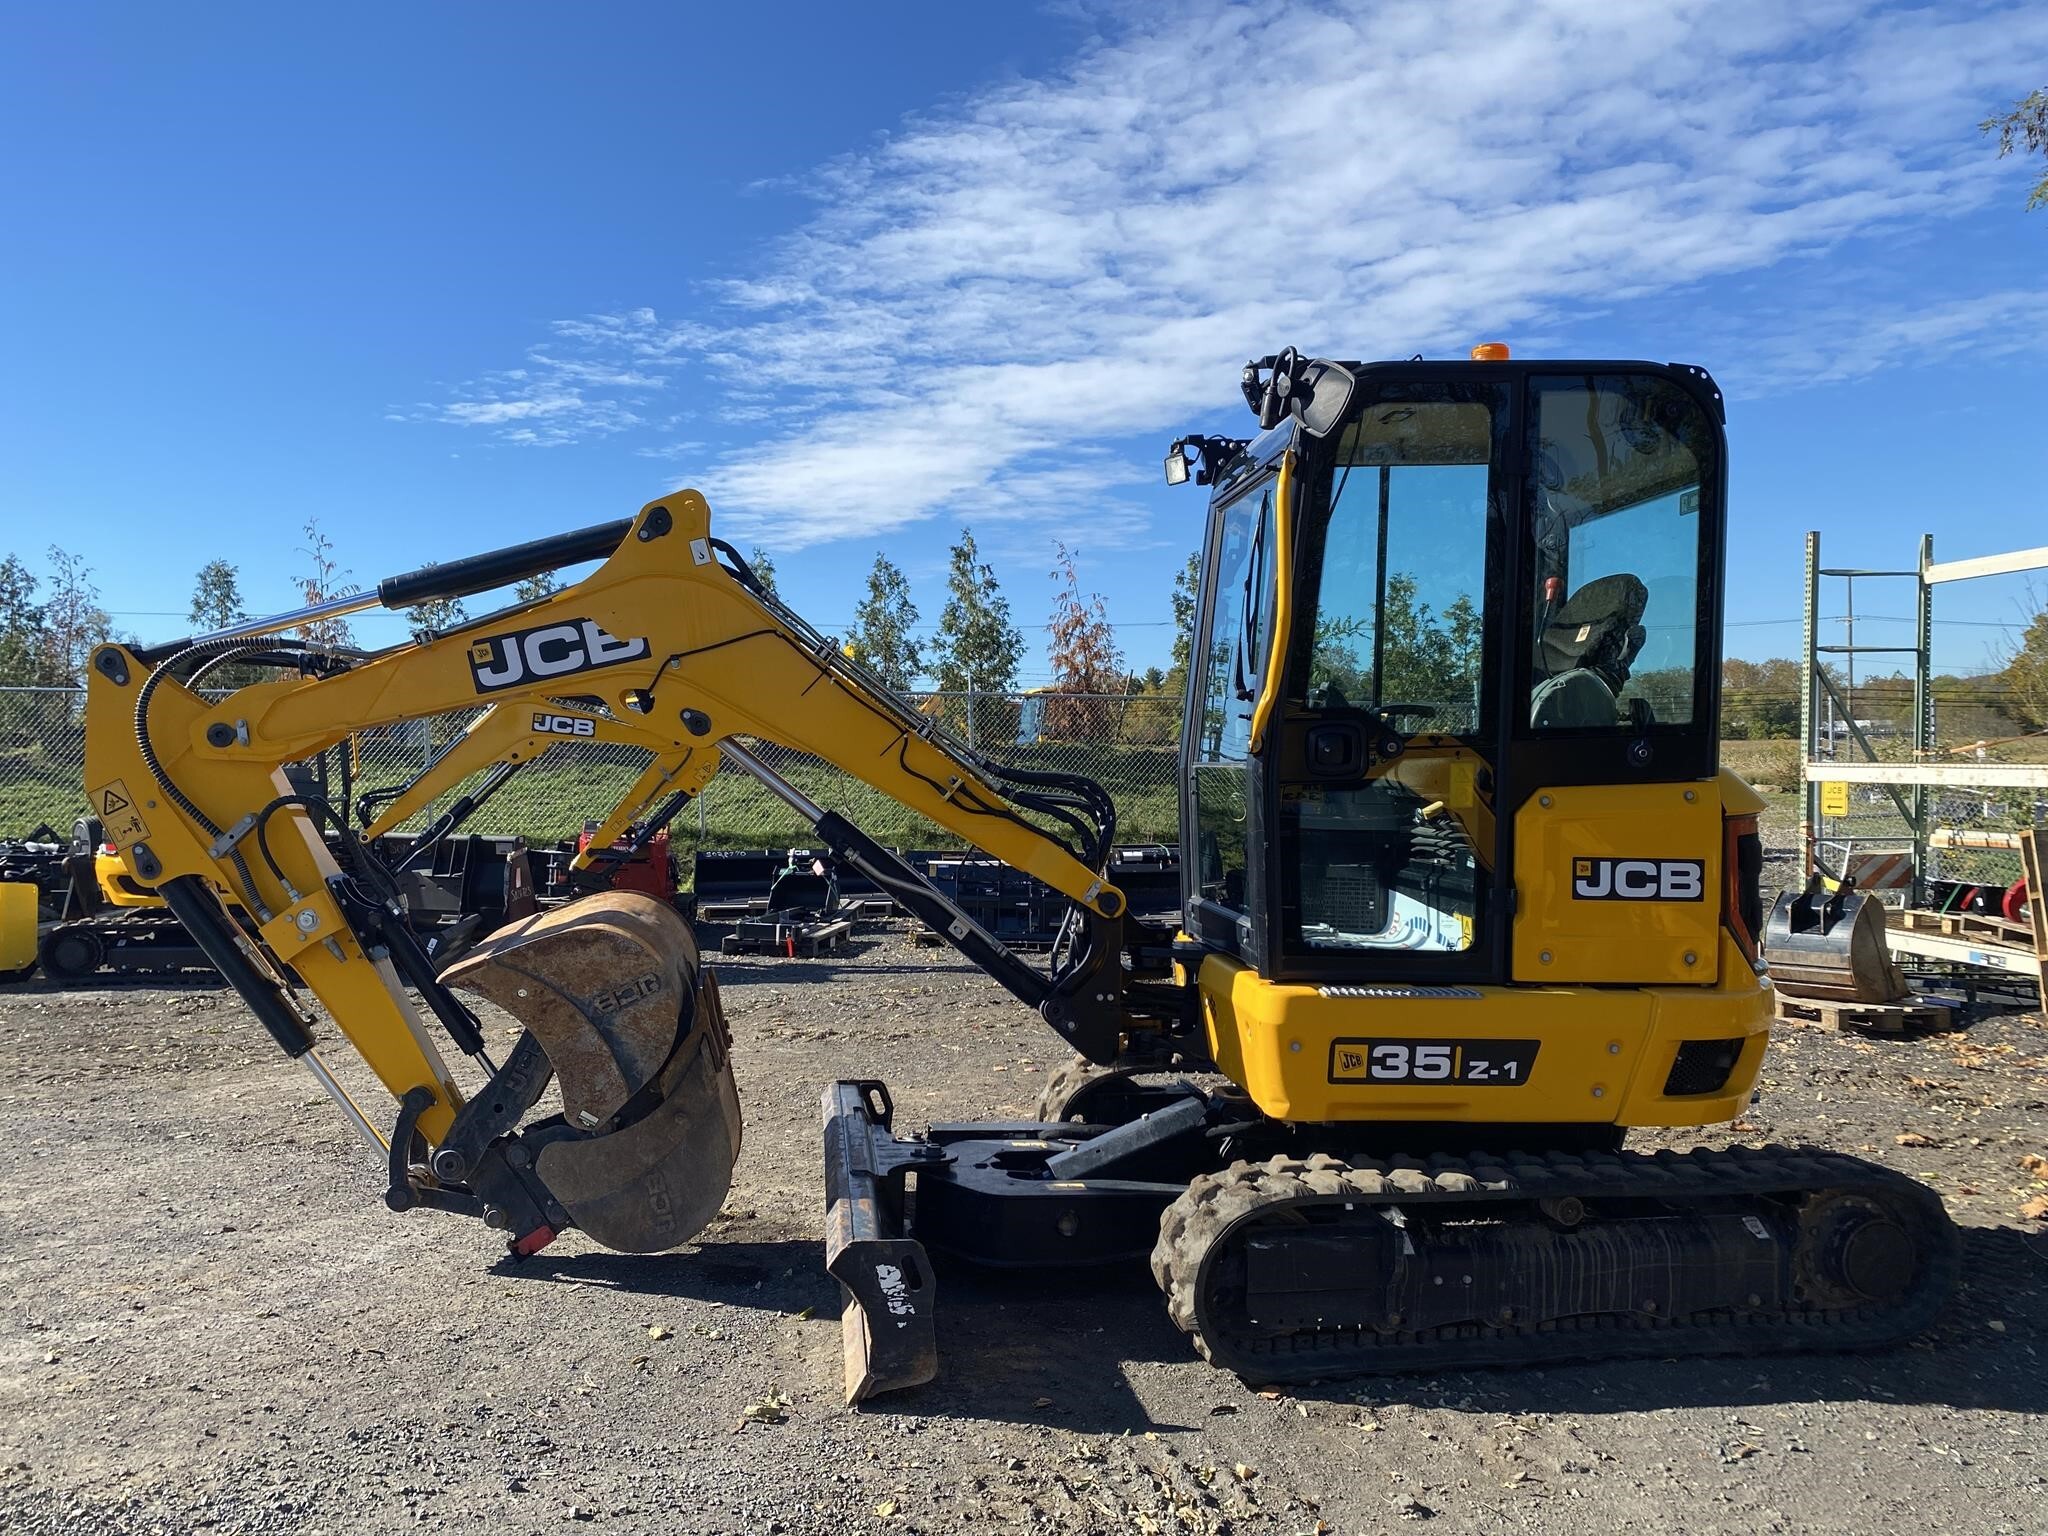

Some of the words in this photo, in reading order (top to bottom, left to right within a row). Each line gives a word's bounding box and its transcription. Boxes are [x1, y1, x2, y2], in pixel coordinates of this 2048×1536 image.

[533, 715, 595, 736] JCB
[1576, 861, 1702, 898] JCB
[1343, 1053, 1362, 1069] JCB
[1371, 1045, 1451, 1079] 35
[1468, 1061, 1518, 1079] Z-1
